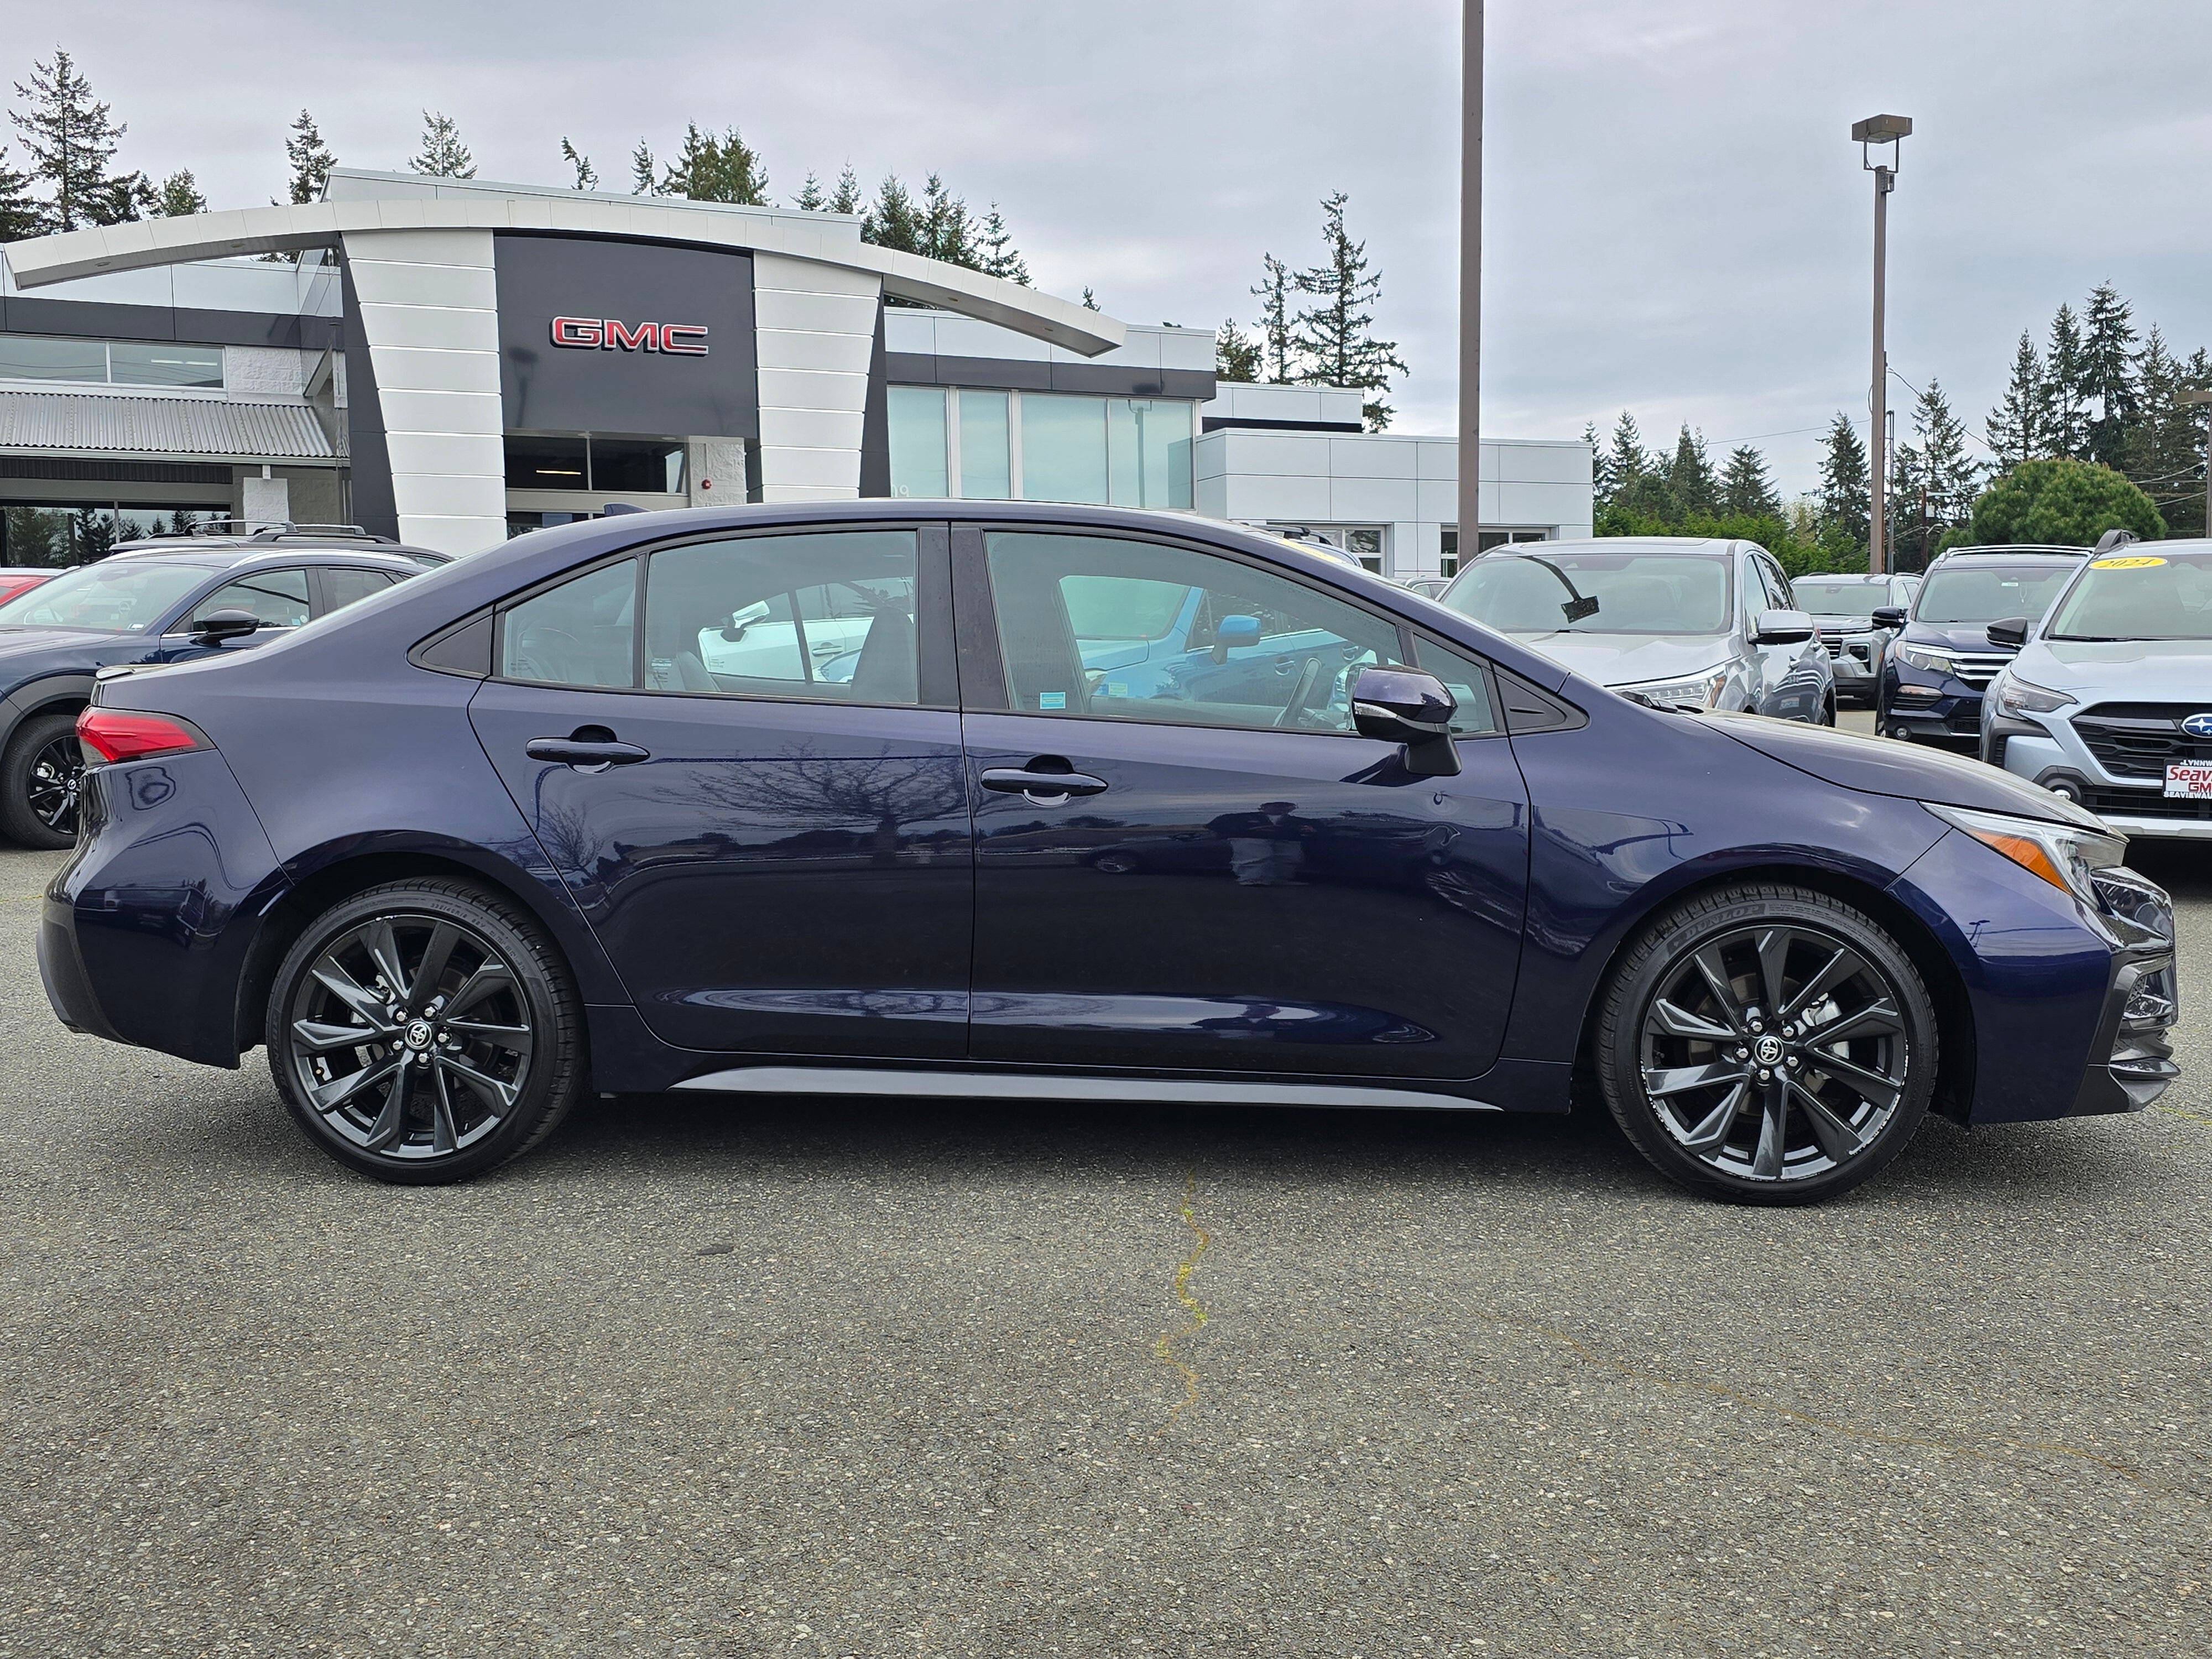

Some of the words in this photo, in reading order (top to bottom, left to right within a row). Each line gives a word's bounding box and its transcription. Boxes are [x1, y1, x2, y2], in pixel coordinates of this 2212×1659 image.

[552, 315, 709, 355] GMC
[2167, 766, 2212, 782] Seav
[1684, 905, 1760, 940] DUNLOP
